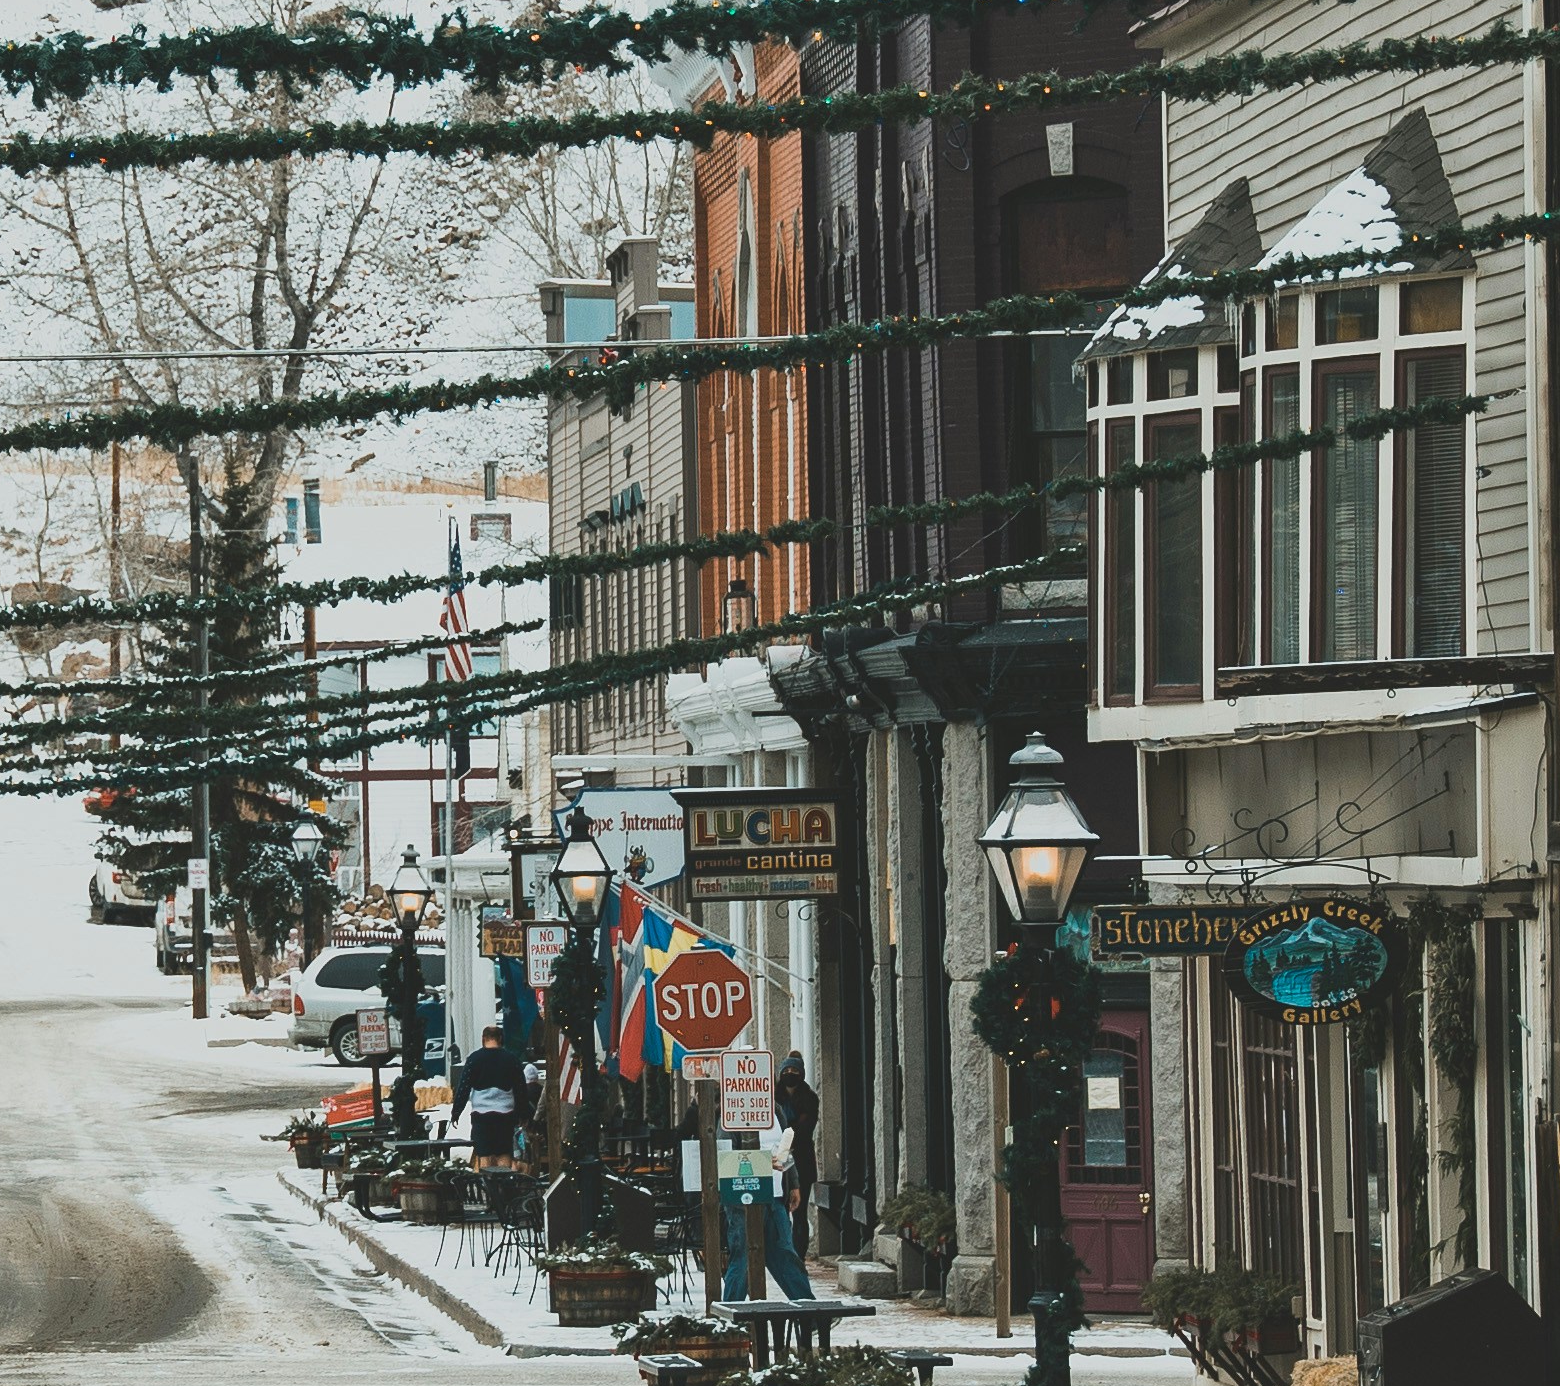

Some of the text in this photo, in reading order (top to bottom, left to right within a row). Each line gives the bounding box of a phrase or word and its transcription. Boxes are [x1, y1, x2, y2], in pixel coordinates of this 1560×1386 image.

[693, 807, 832, 847] LUCHA
[694, 850, 833, 870] grande cantina
[696, 875, 834, 894] fresh healthy mexican bbq
[1238, 900, 1384, 946] Grizzly Creek
[539, 930, 555, 942] NO
[661, 980, 746, 1021] STOP
[1282, 998, 1362, 1024] Gallery
[366, 1015, 379, 1024] NO
[360, 1024, 386, 1033] PARKING
[737, 1059, 757, 1075] NO
[725, 1077, 770, 1093] PARKING
[726, 1097, 769, 1108] THIS SIDE
[726, 1111, 770, 1122] OF STREET
